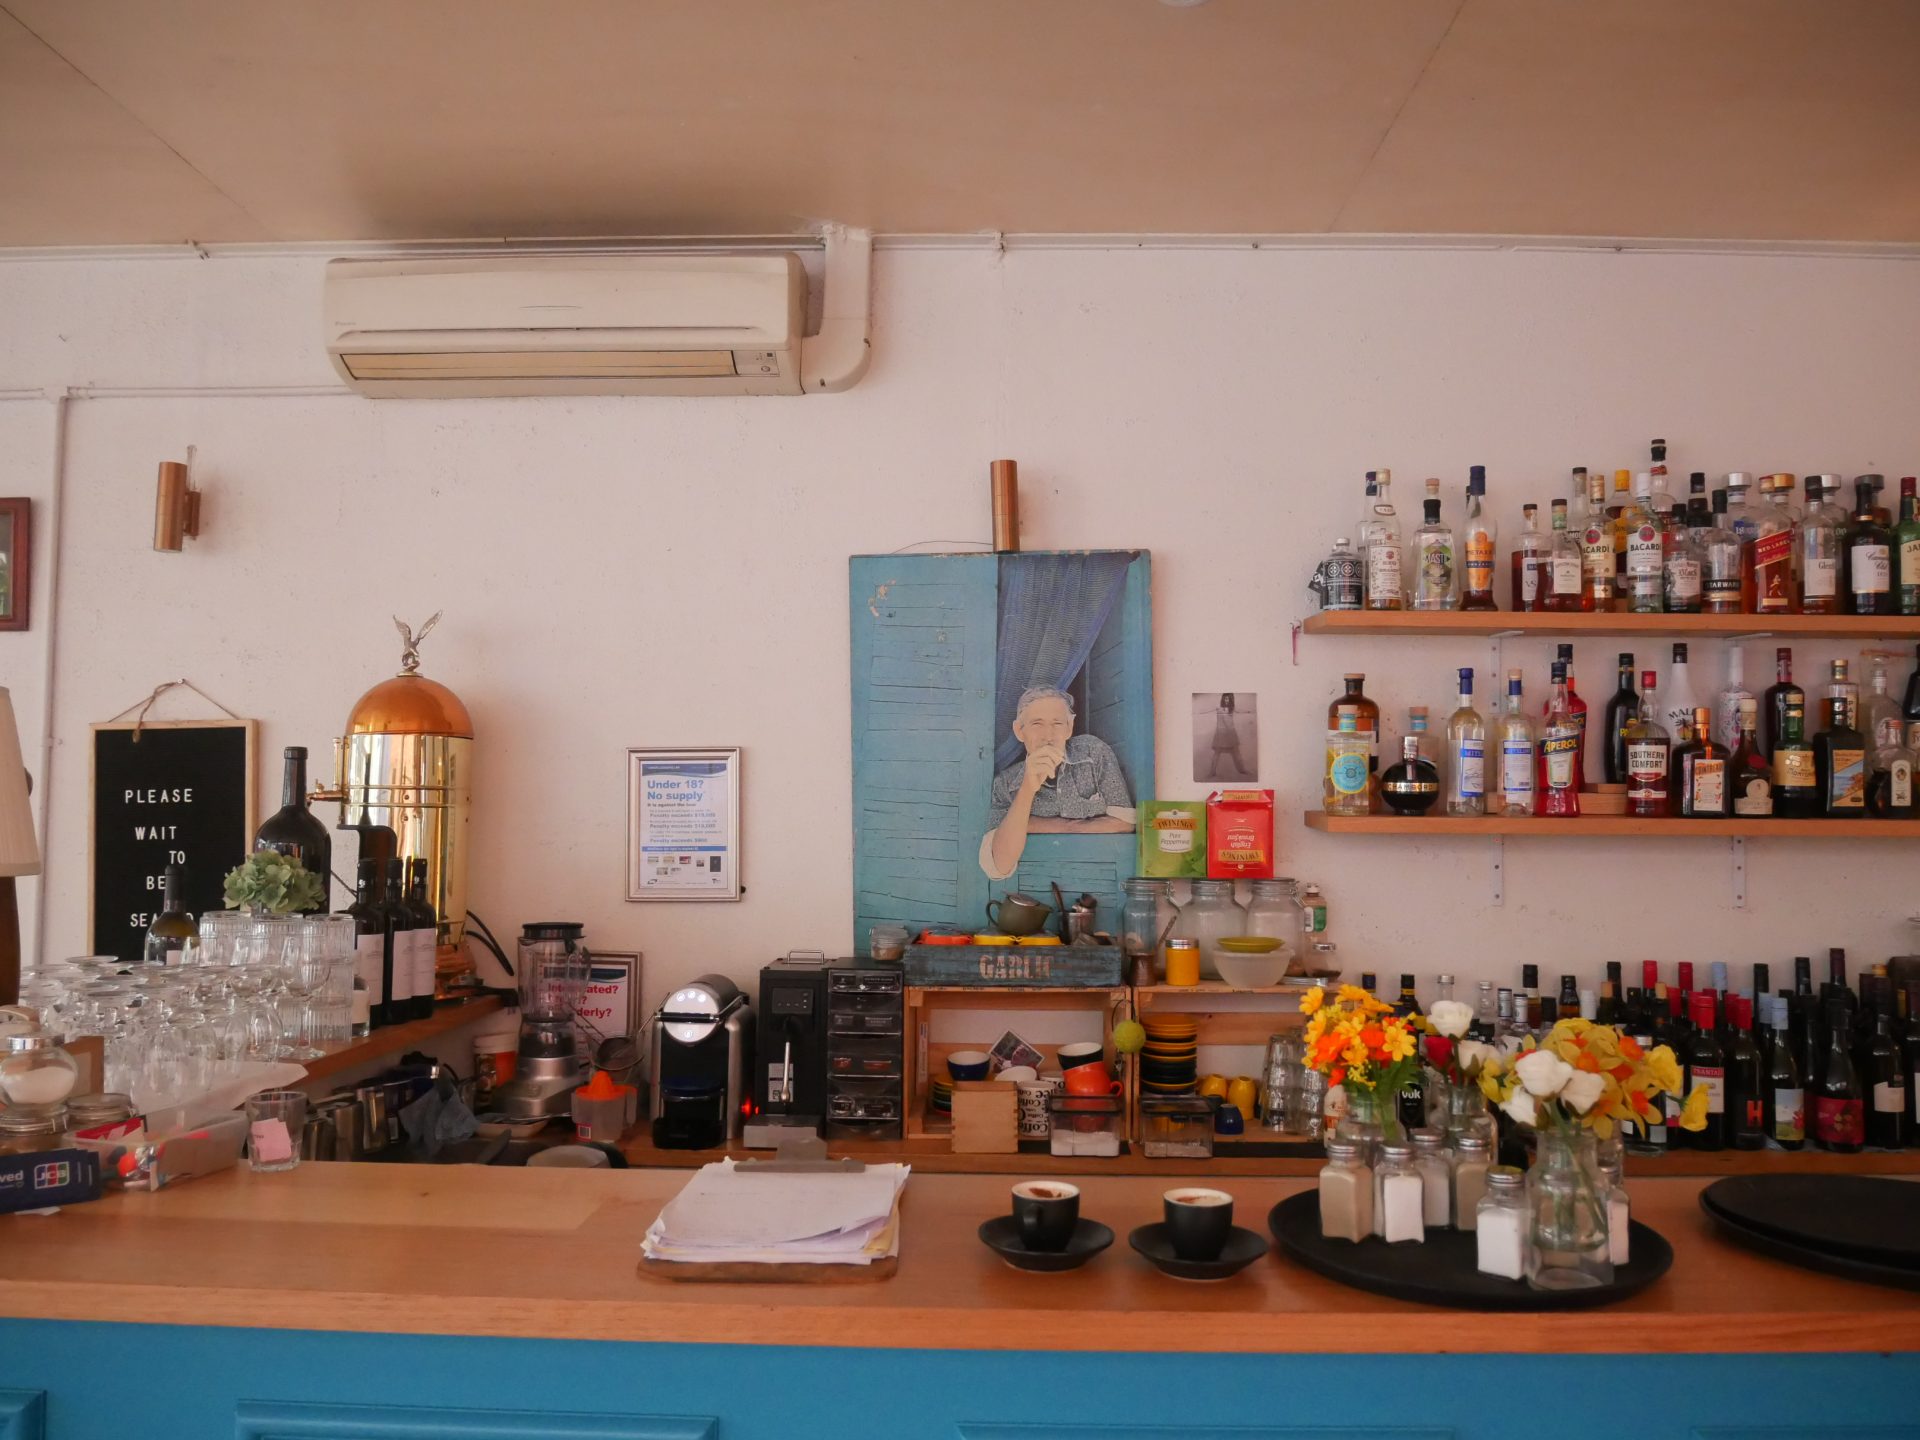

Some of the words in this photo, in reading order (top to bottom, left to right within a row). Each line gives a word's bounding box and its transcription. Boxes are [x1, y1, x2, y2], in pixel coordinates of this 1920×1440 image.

[1668, 708, 1693, 719] MAL
[1544, 738, 1577, 753] APEROL
[1630, 751, 1665, 760] SOUTHERN
[1631, 760, 1663, 768] COMFORT
[647, 780, 681, 789] Under
[684, 780, 704, 789] 18?
[1386, 783, 1433, 791] CHAMBORD
[125, 789, 193, 803] PLEASE
[647, 791, 663, 800] No
[666, 791, 703, 802] supply
[1157, 819, 1194, 829] TWININGS
[135, 826, 177, 840] WAIT
[169, 850, 186, 864] TO
[1221, 851, 1259, 860] TWININGS
[146, 876, 166, 890] BE
[1401, 1089, 1421, 1099] vok
[0, 1169, 24, 1182] ved
[36, 1170, 66, 1181] JCB
